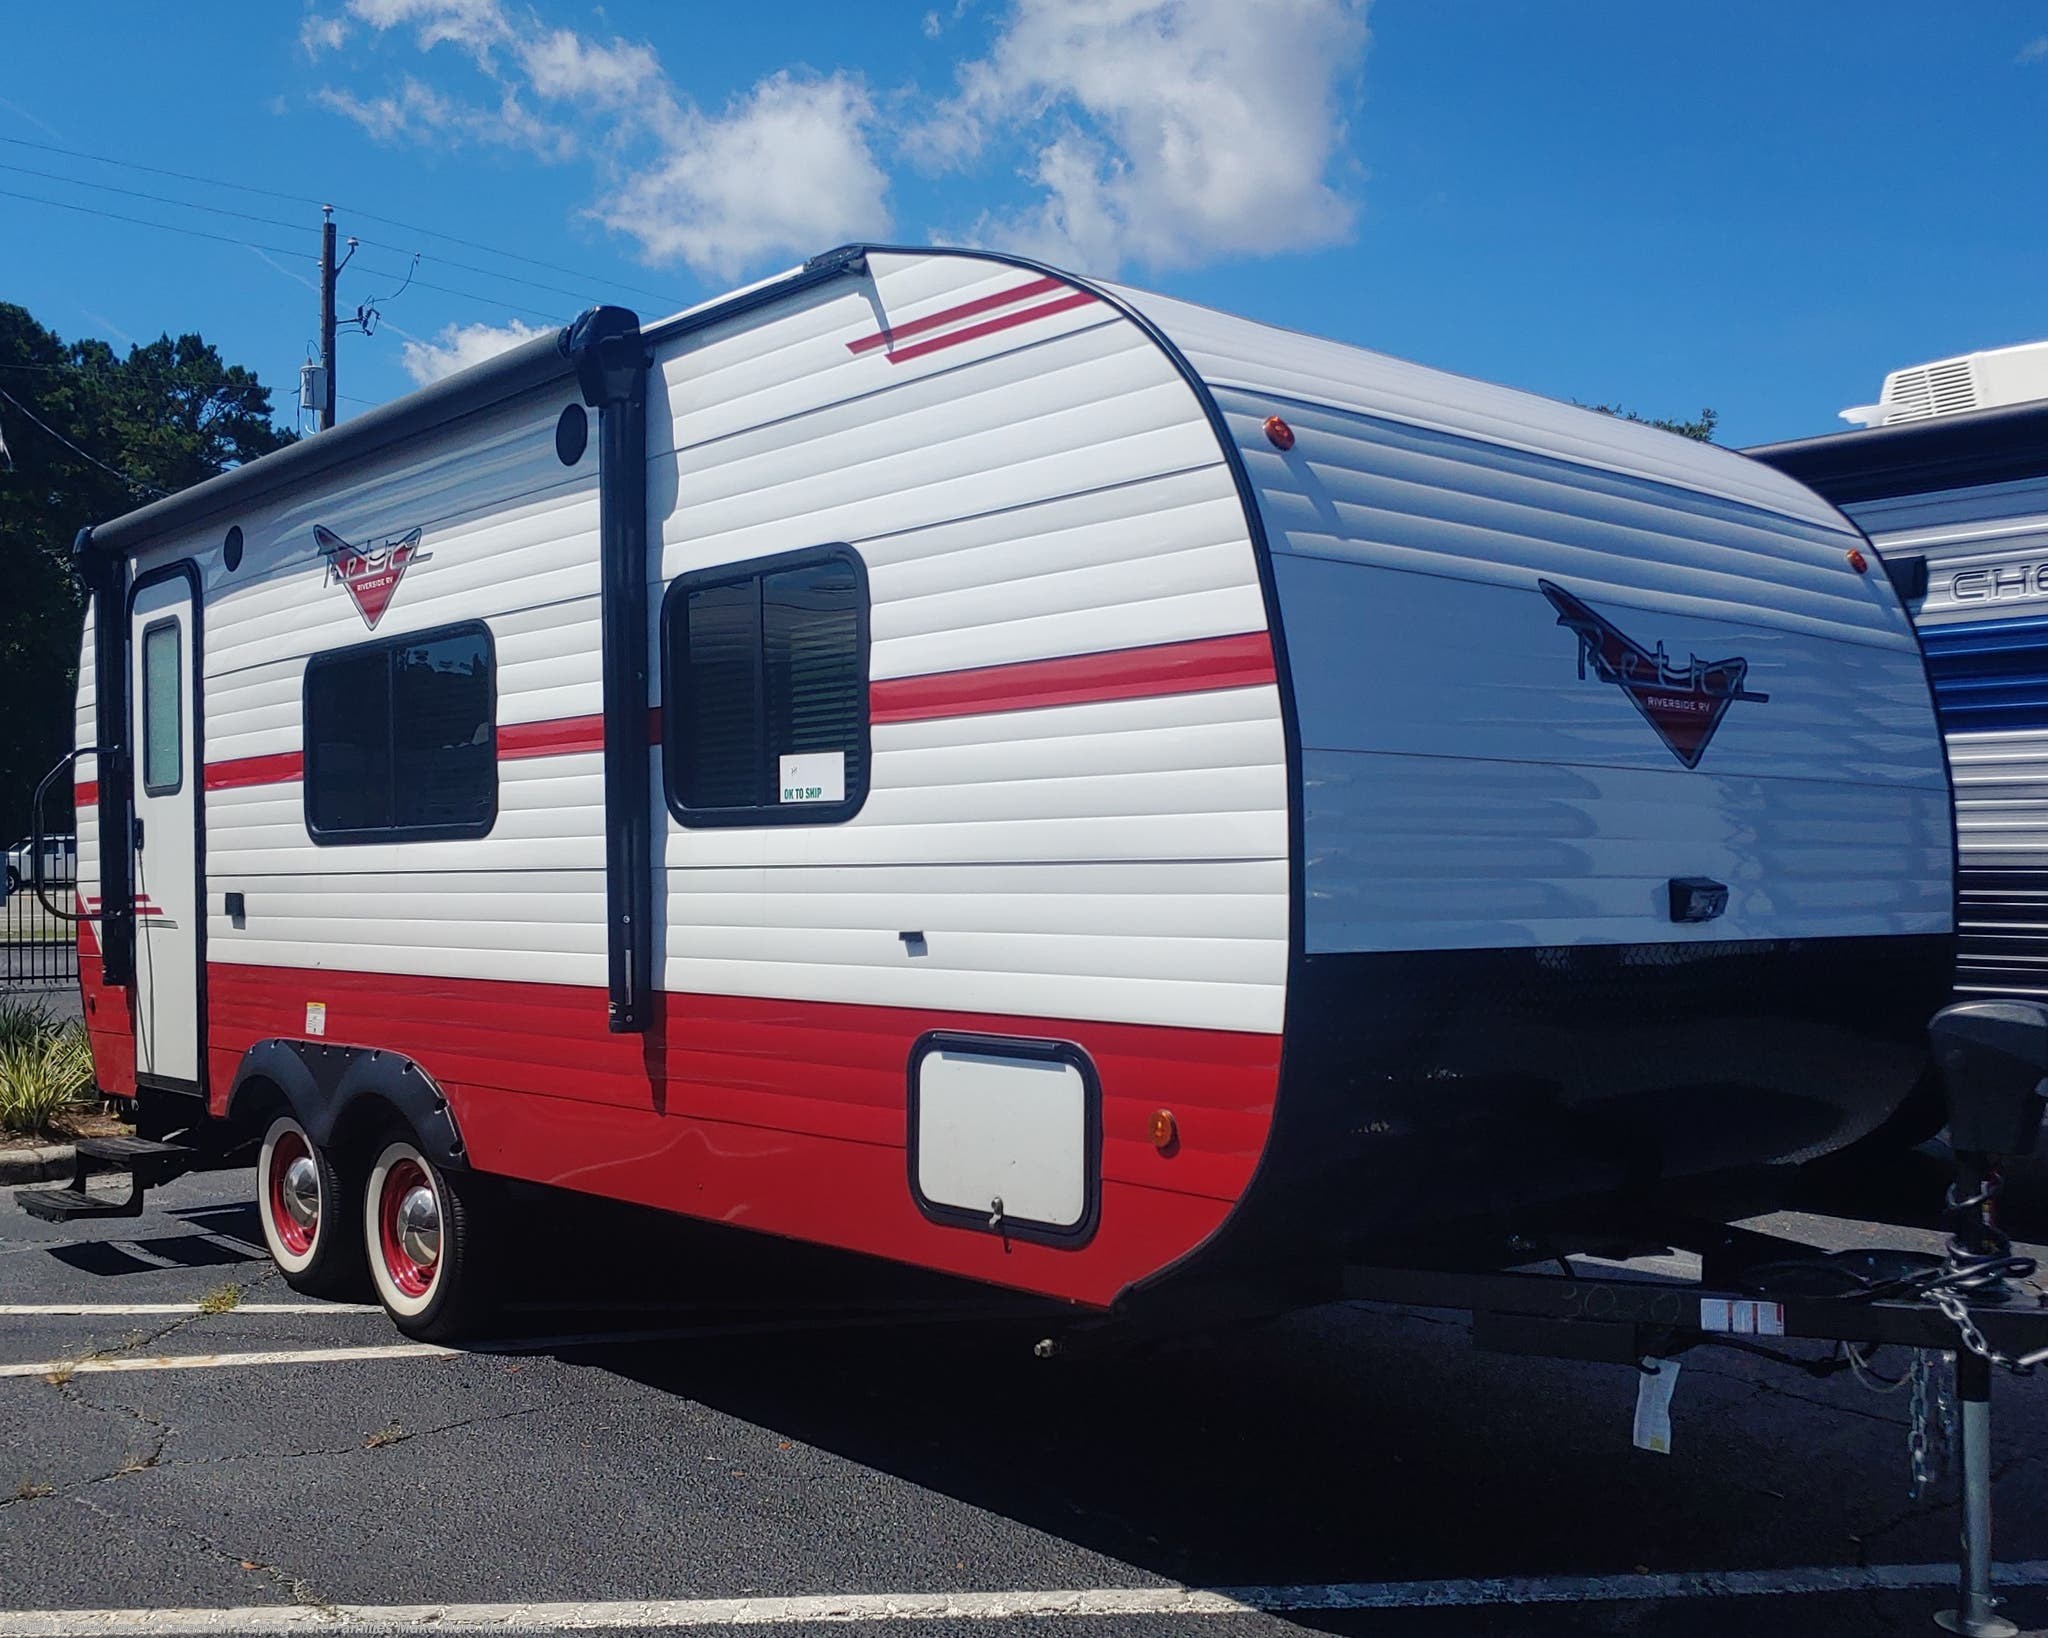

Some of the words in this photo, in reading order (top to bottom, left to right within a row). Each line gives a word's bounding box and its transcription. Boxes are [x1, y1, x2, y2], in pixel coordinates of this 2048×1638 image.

[357, 579, 385, 591] RIVERSIDE
[385, 576, 393, 584] RV
[1647, 696, 1696, 710] RIVERSIDE
[1698, 702, 1710, 712] RV
[784, 788, 794, 799] OK
[795, 787, 804, 799] TO
[805, 787, 822, 799] SHIP
